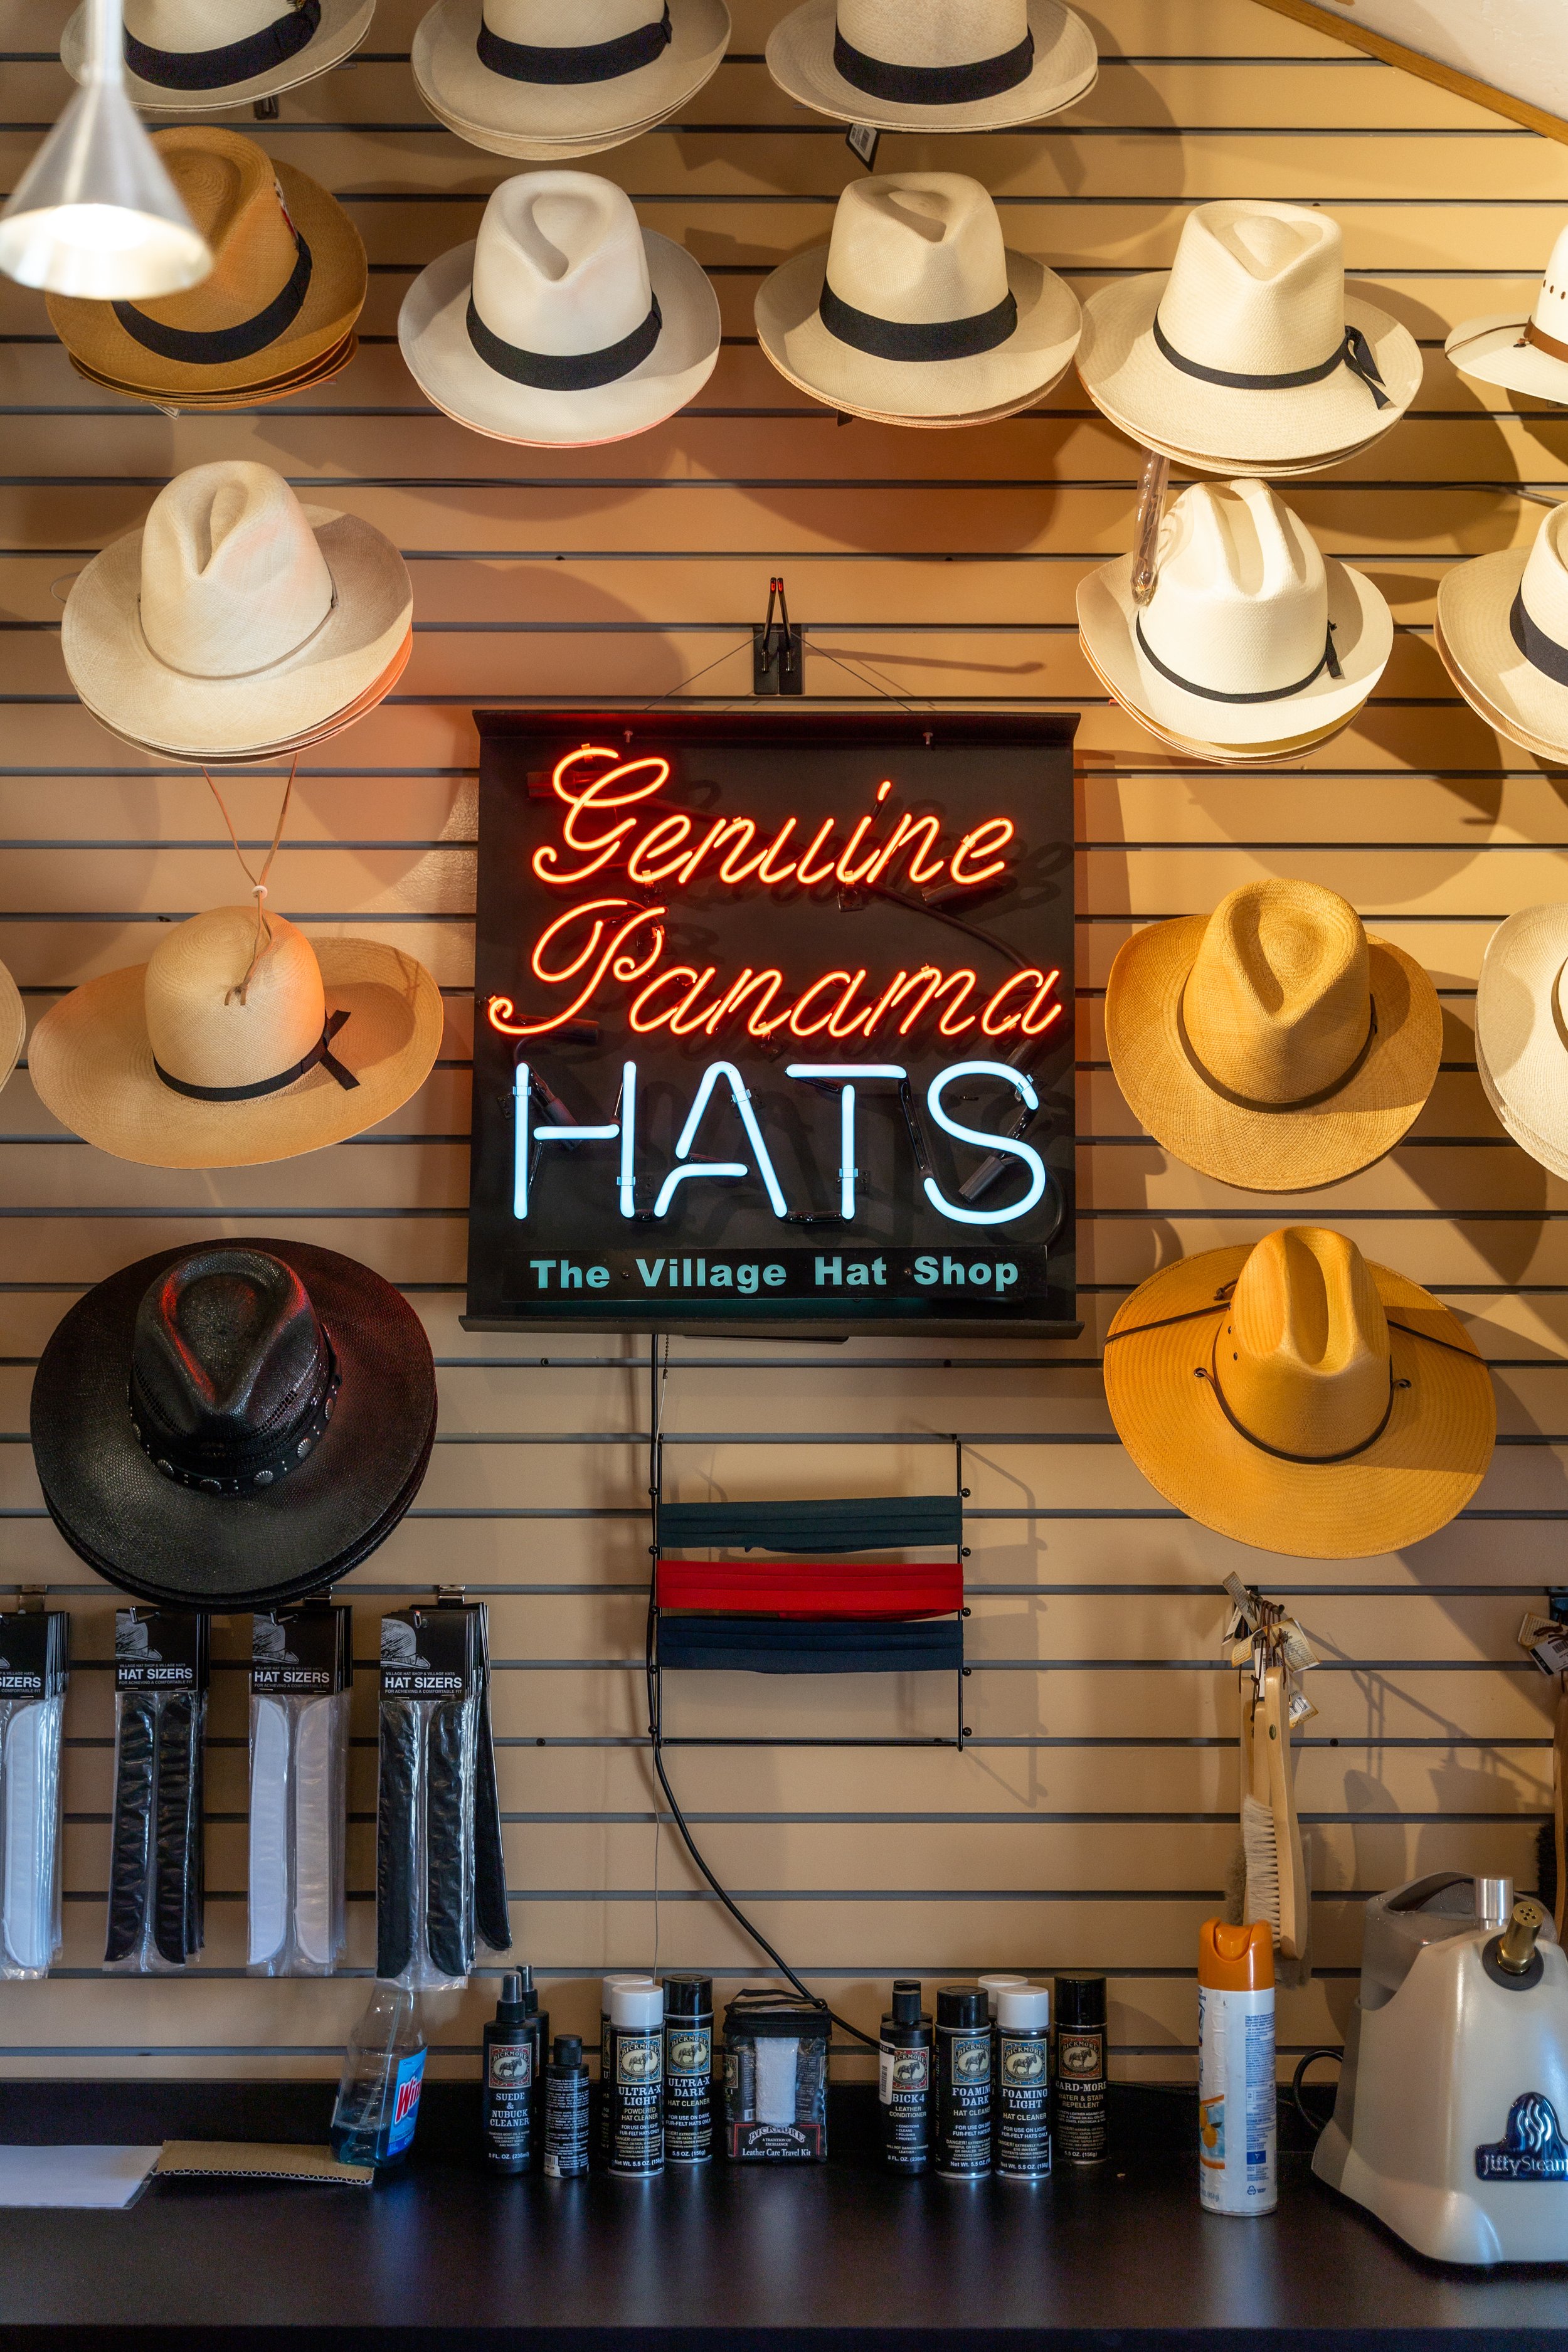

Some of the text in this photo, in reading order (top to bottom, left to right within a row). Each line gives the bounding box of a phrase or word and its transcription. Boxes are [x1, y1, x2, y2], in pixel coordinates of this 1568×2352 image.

[532, 746, 1015, 884] Genuine
[488, 899, 1062, 1036] Panama
[514, 1060, 1046, 1224] HATS
[529, 1256, 1019, 1294] The Village Hat Shop
[119, 1668, 193, 1680] HAT SIZERS
[255, 1671, 330, 1683] HAT SIZERS
[0, 1677, 41, 1688] IZERS
[385, 1677, 462, 1688] HAT SIZERS
[672, 2036, 708, 2046] BICKMORE
[622, 2044, 659, 2055] BICKMORE
[1006, 2047, 1043, 2058] BICKMORE
[1062, 2042, 1098, 2052] BICKMORE
[494, 2052, 528, 2061] BICKMORE
[896, 2054, 926, 2064] ICKMORE
[668, 2076, 710, 2087] ULTRA-X
[618, 2084, 661, 2095] ULTRA-X
[674, 2087, 705, 2097] DARK
[1002, 2089, 1047, 2099] FOAMING
[495, 2092, 525, 2100] SUEDE
[624, 2095, 657, 2106] LIGHT
[961, 2095, 989, 2106] DARK
[681, 2097, 710, 2107] CLEANER
[1009, 2099, 1042, 2109] LIGHT
[492, 2109, 528, 2118] NUBUCK
[633, 2113, 658, 2121] CLEANER
[1017, 2112, 1047, 2121] CLEANER
[490, 2117, 529, 2127] CLEANER
[748, 2125, 806, 2144] BICKMORE
[742, 2148, 765, 2156] Leather
[766, 2148, 780, 2156] Care
[781, 2148, 800, 2156] Travel
